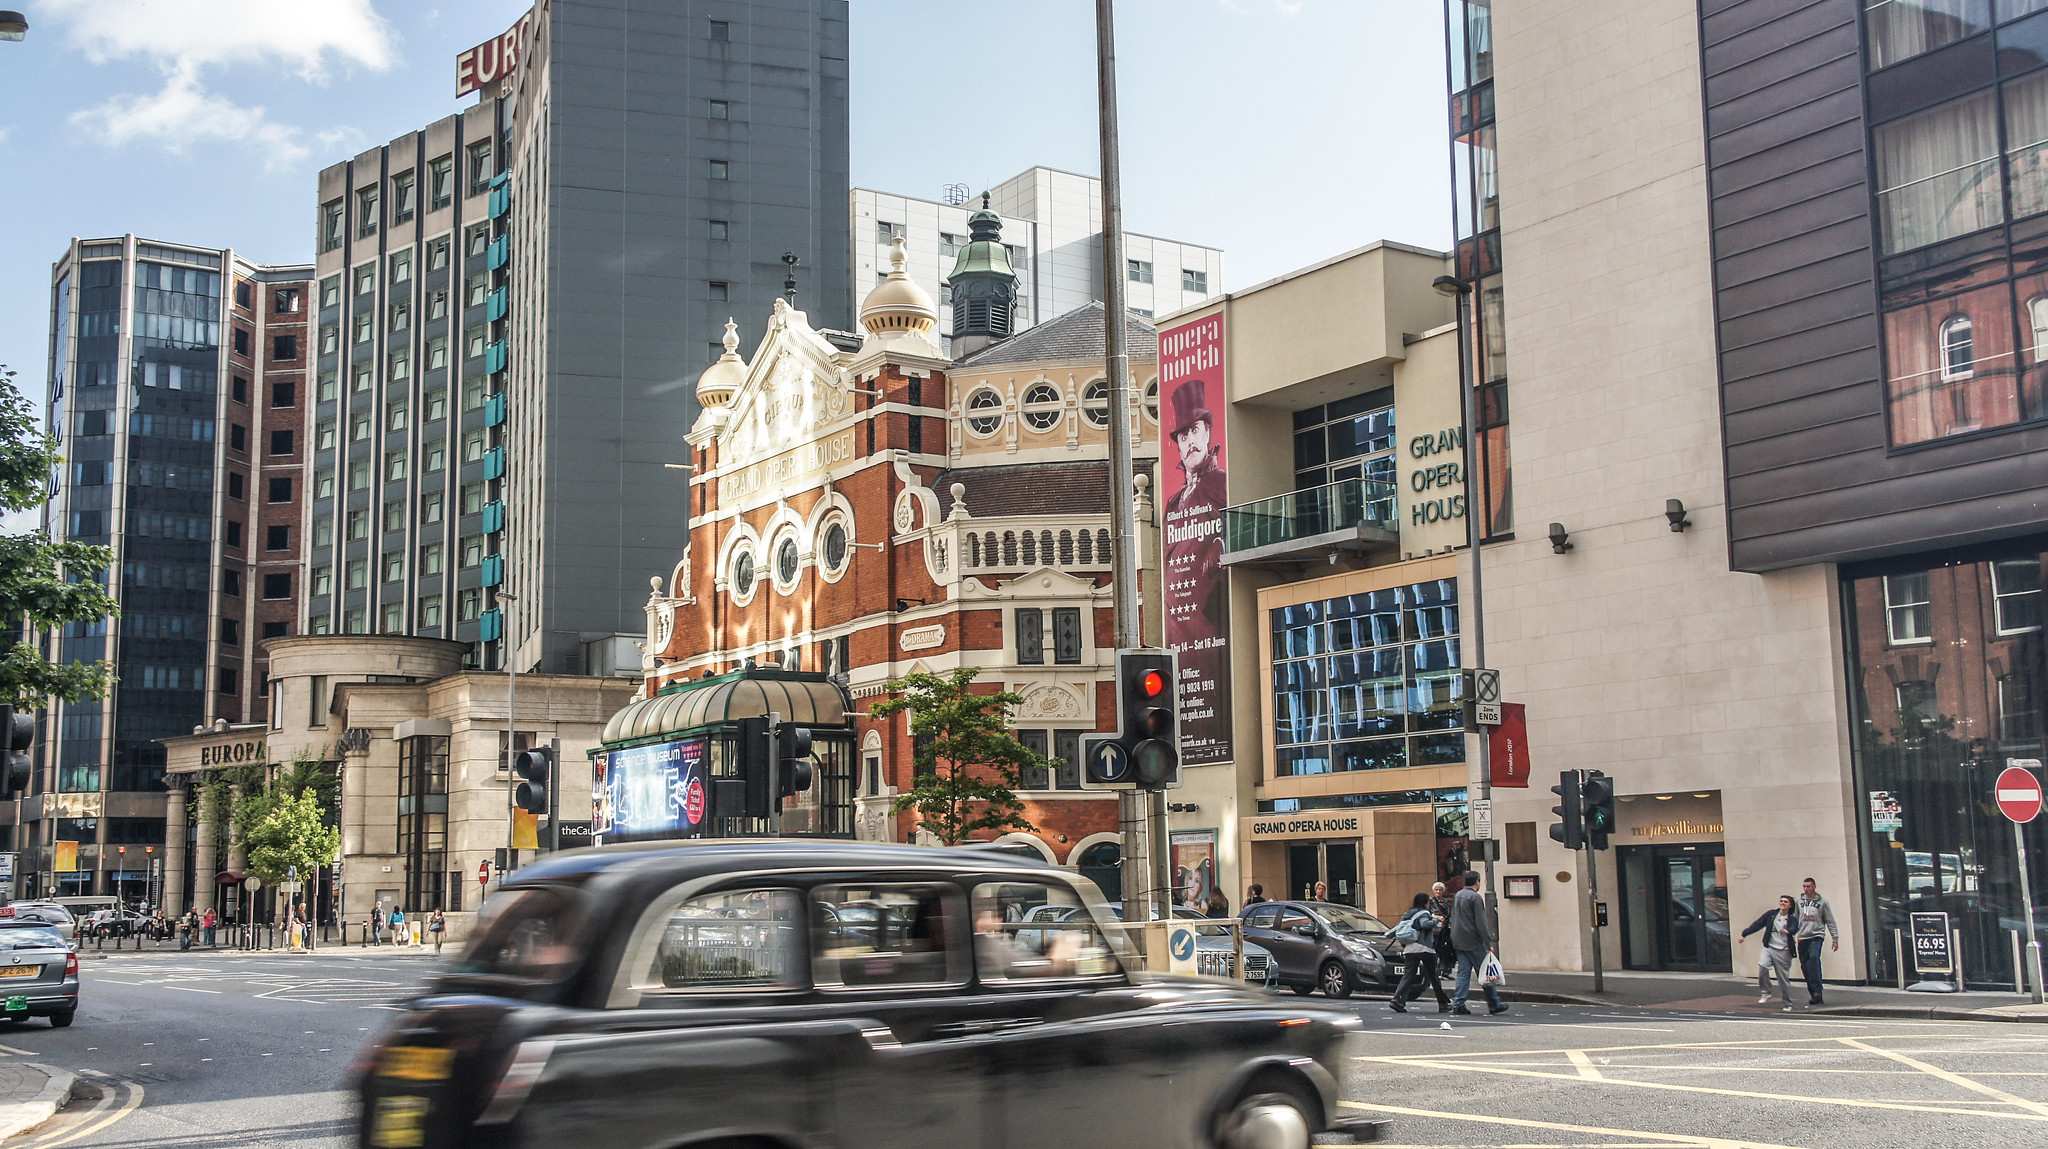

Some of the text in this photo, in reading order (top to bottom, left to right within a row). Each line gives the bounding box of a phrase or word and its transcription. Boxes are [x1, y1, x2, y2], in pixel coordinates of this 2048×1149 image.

[1163, 320, 1218, 357] opera
[1163, 344, 1219, 382] north
[1409, 425, 1463, 459] GRAN
[725, 466, 761, 500] GRAND
[765, 456, 798, 486] OPER
[1410, 462, 1464, 493] OPER
[1167, 502, 1213, 521] Gilbert & Sullivan's
[1411, 494, 1465, 526] HOUS
[1167, 518, 1222, 544] Ruddigore
[911, 631, 935, 644] DRAMA
[1181, 641, 1188, 652] 14
[1194, 639, 1204, 650] Sat
[1204, 637, 1211, 649] 16
[1211, 636, 1226, 647] June
[1182, 667, 1200, 680] Office:
[1186, 682, 1200, 693] 9024
[1186, 696, 1205, 708] online:
[1479, 712, 1498, 721] ENDS
[201, 740, 267, 766] EUROPA
[561, 825, 592, 836] theCau
[1253, 818, 1358, 834] GRAND OPERA HOUSE
[1649, 820, 1707, 839] fitzwilliam
[1709, 823, 1723, 833] HO
[1917, 937, 1945, 949] £6.95
